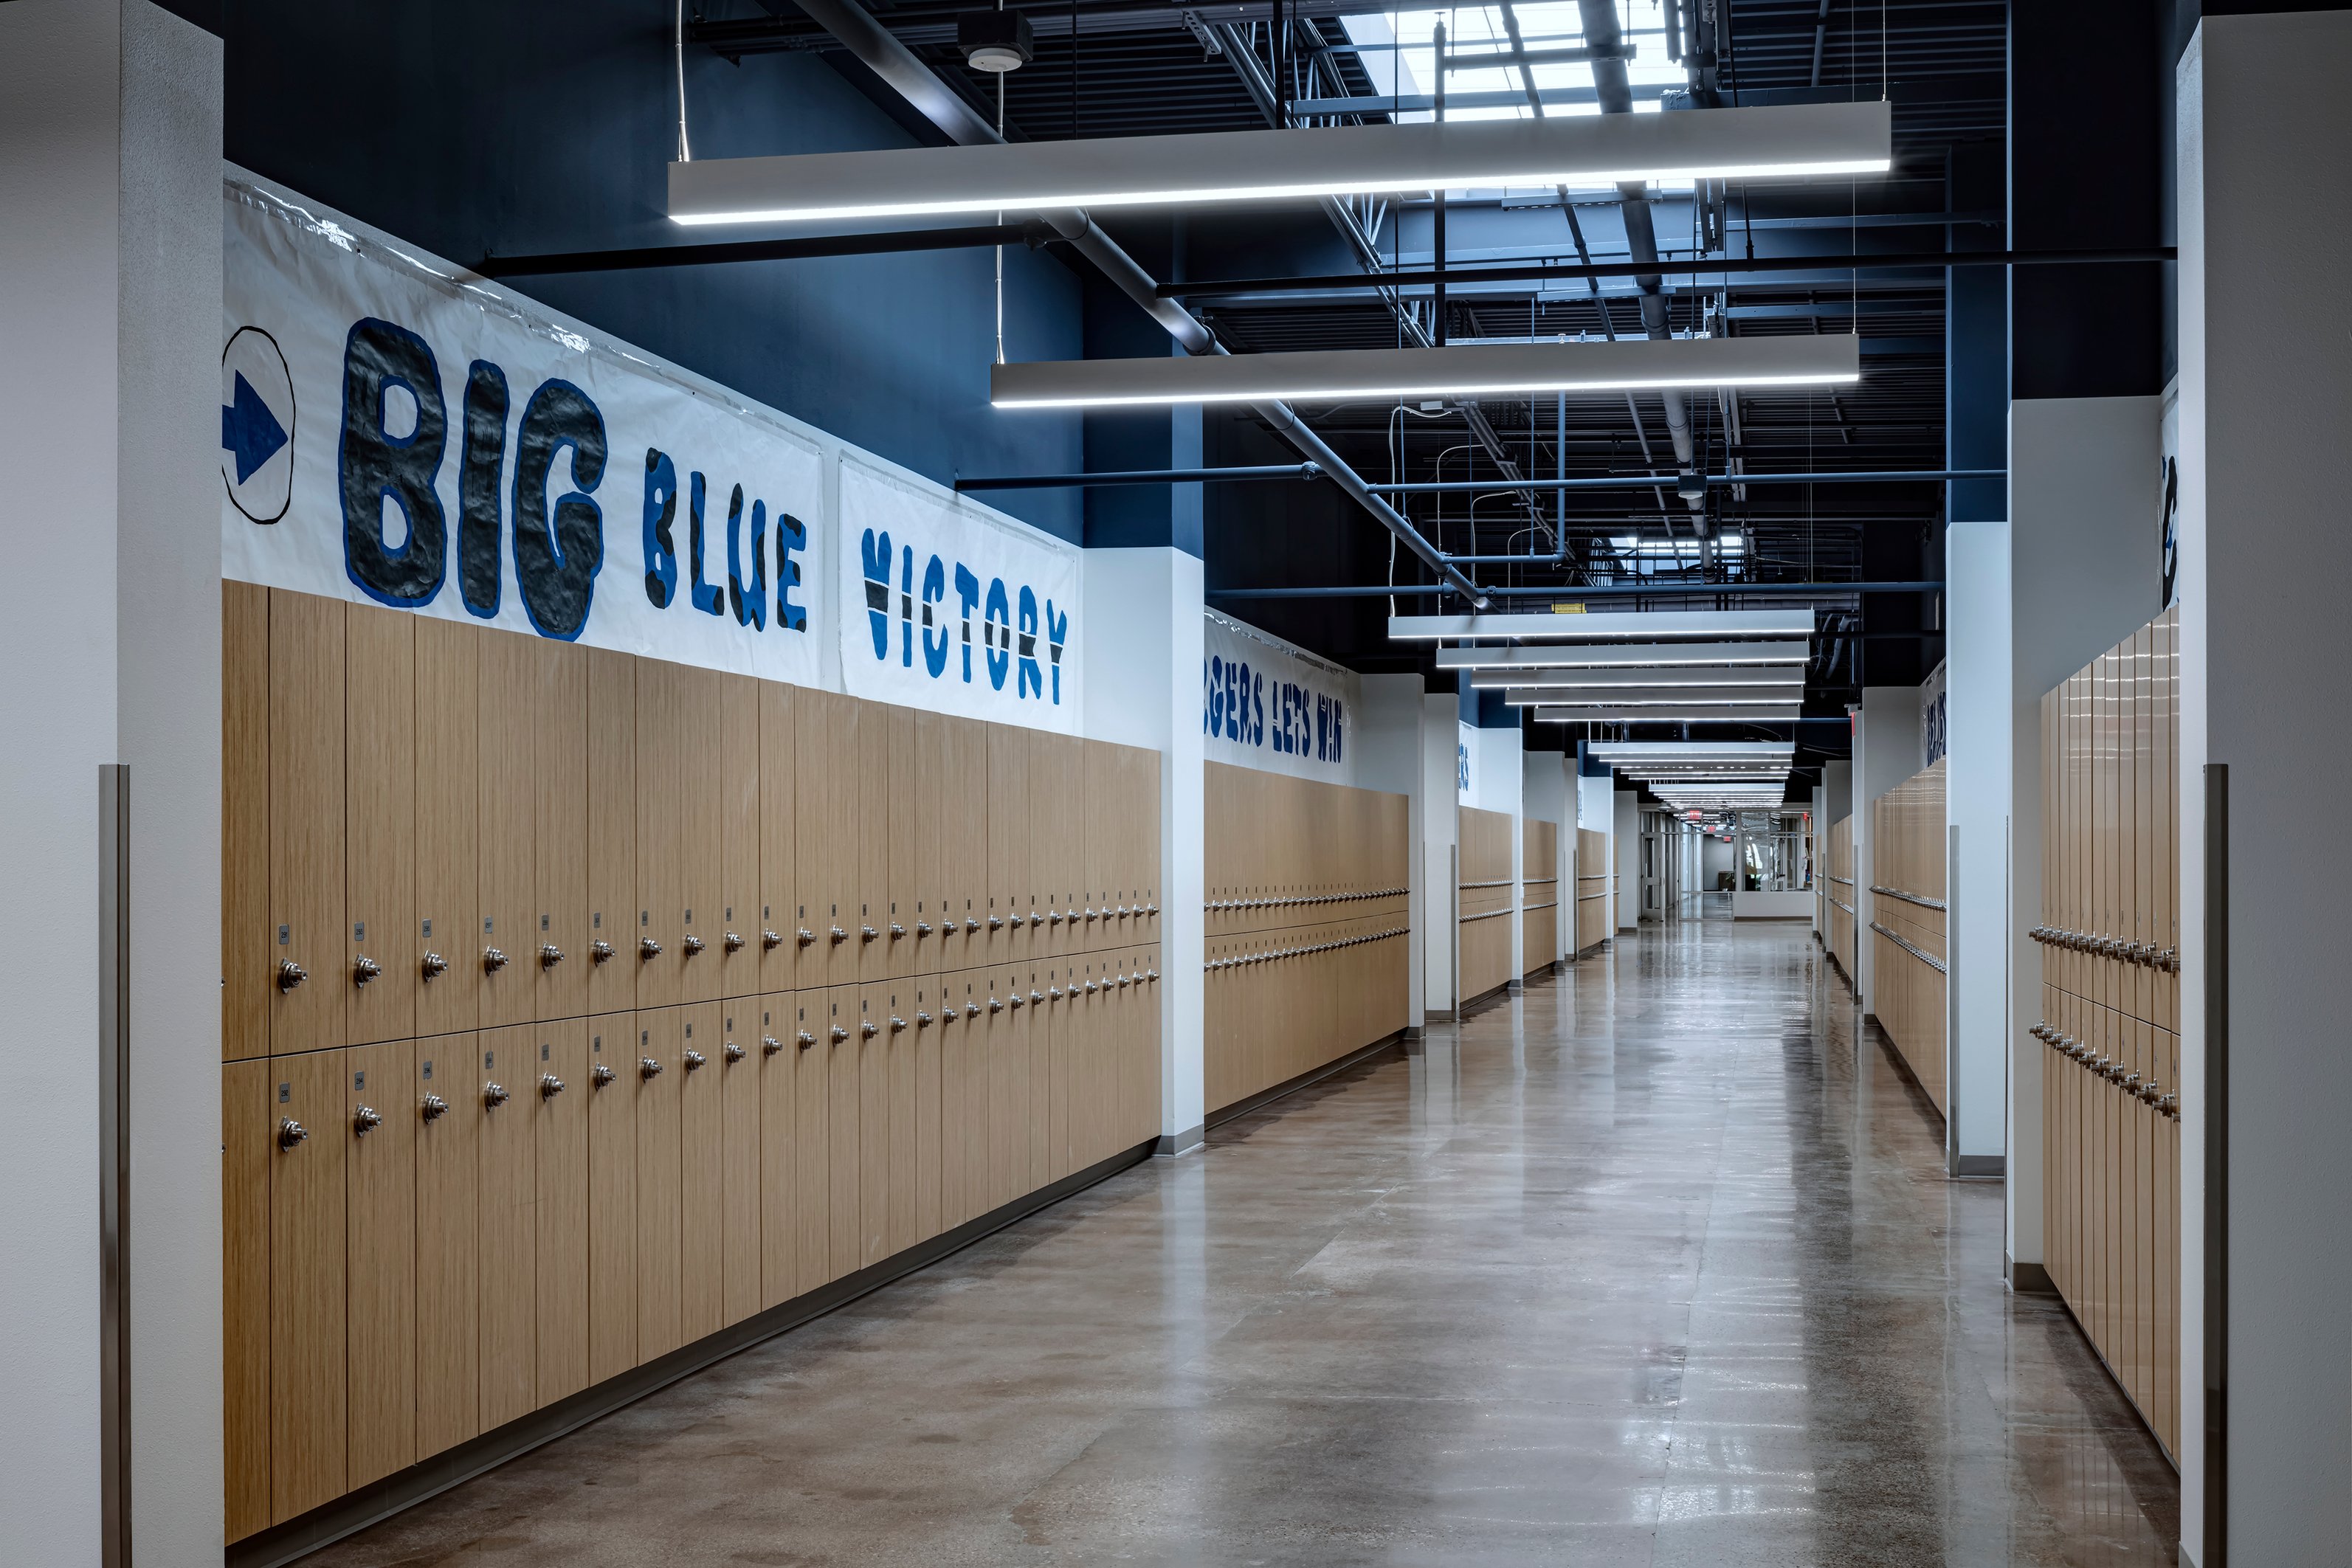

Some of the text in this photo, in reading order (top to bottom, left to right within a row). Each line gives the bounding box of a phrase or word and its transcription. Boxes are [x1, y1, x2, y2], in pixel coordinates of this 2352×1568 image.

[338, 316, 1068, 705] BIG BLUE VICTORY
[1204, 655, 1342, 764] GERS LETS WIN
